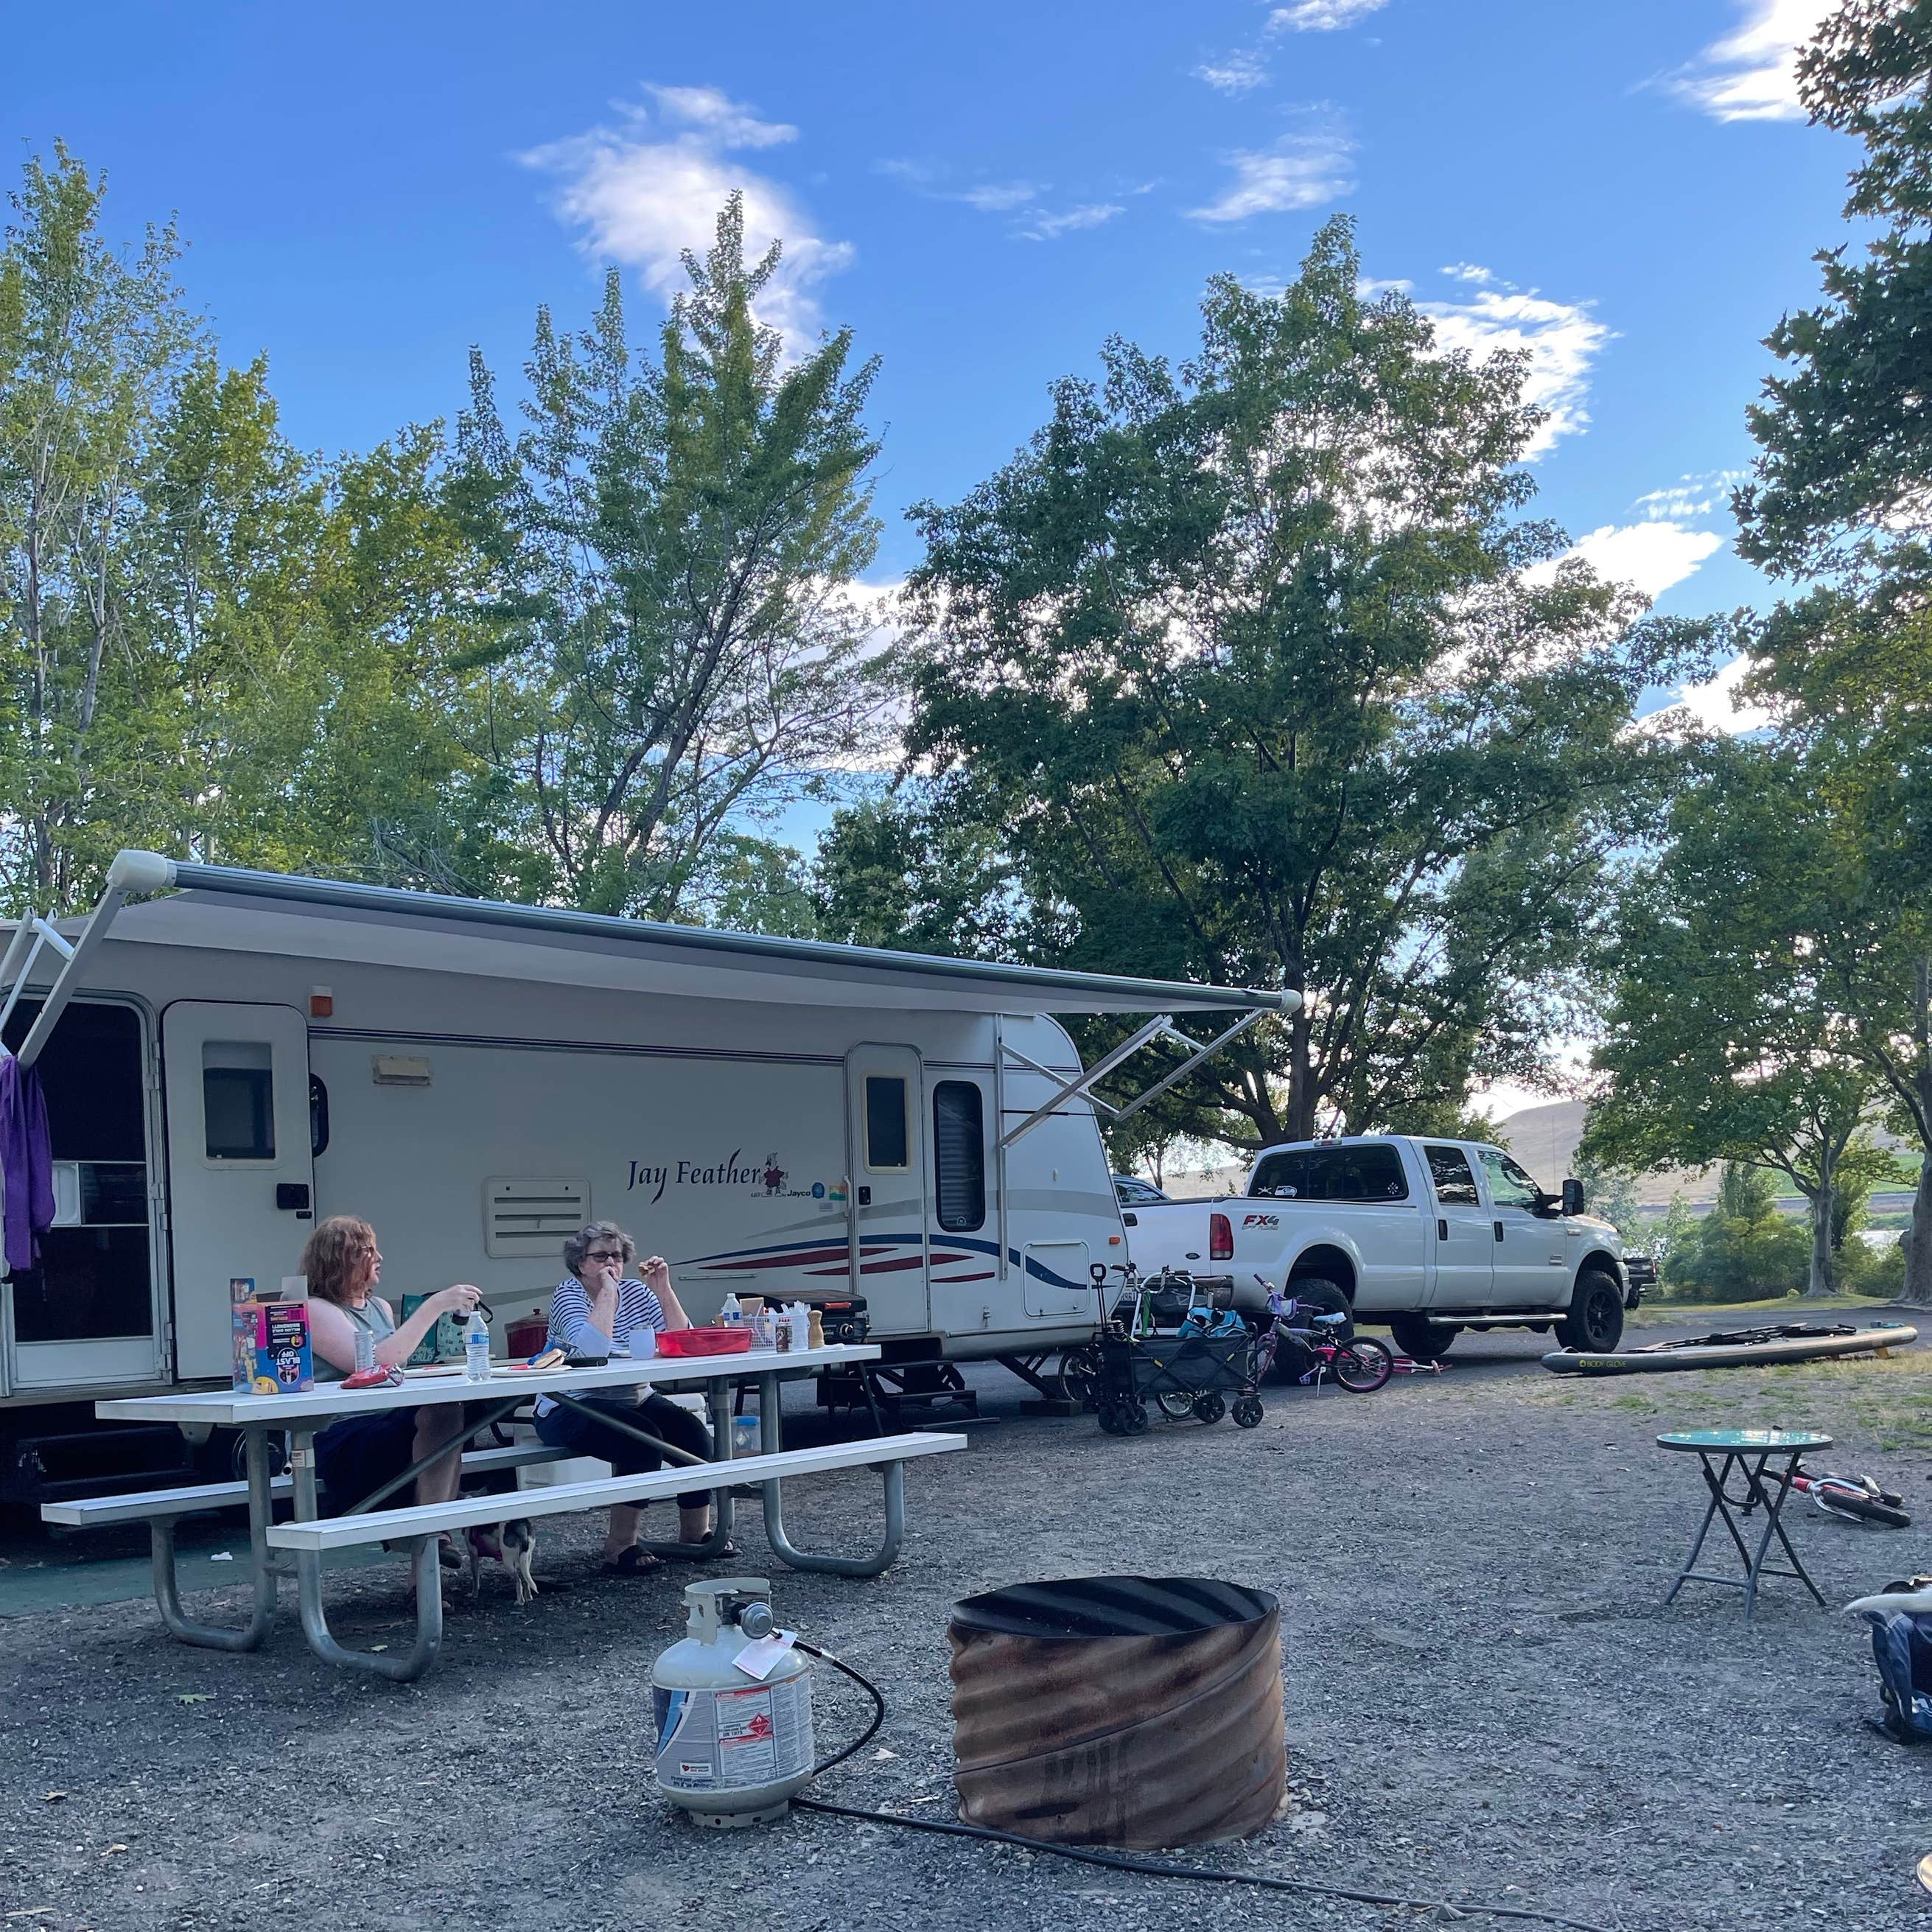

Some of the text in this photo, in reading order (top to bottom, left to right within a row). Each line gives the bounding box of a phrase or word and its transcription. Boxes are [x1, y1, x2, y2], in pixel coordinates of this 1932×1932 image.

[626, 1147, 761, 1205] Jay Feather
[787, 1189, 811, 1198] Jayco
[1243, 1214, 1280, 1225] FX4
[276, 1357, 301, 1365] BLAST
